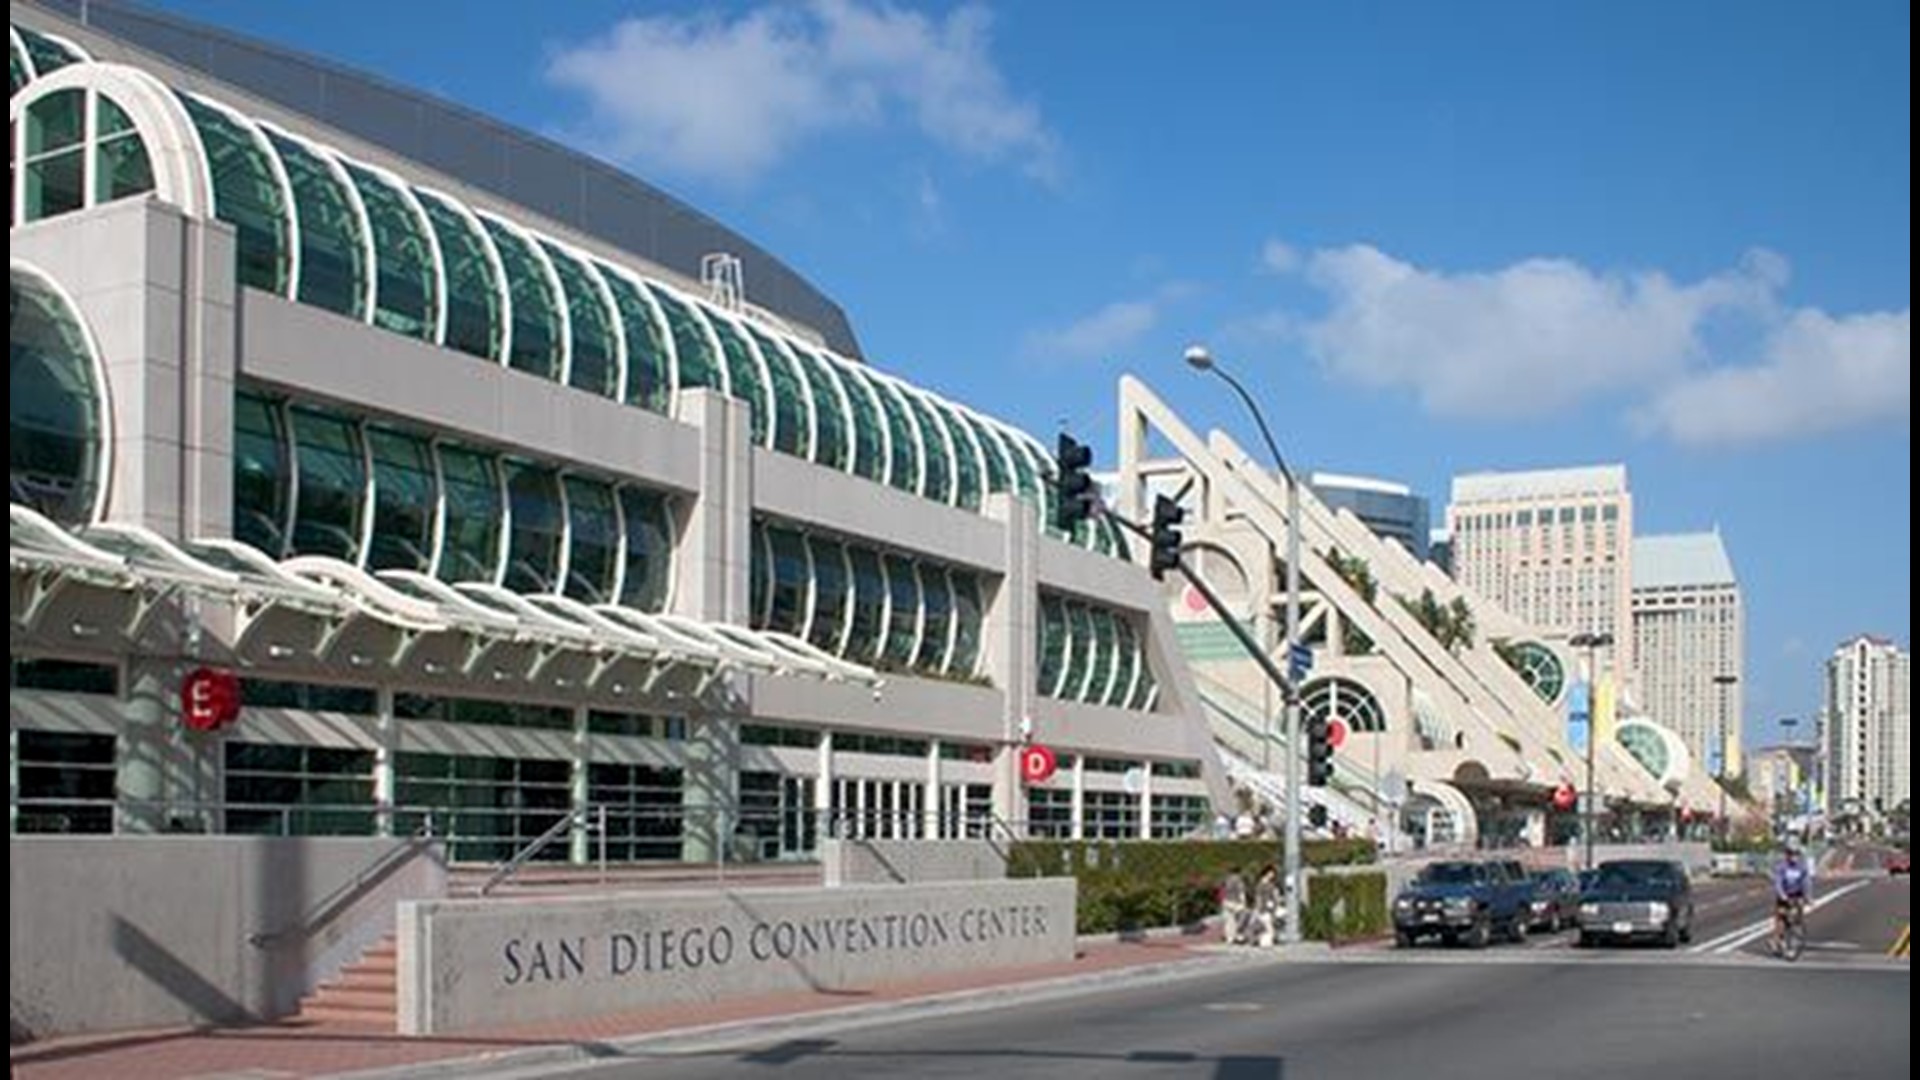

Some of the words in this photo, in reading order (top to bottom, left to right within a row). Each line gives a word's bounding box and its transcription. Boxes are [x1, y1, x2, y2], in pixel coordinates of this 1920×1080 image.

[192, 680, 213, 717] E
[1027, 752, 1046, 776] D
[503, 937, 585, 985] SAN
[610, 925, 734, 975] DIEGO
[750, 911, 949, 960] CONVENTION
[959, 904, 1049, 943] CENTER
